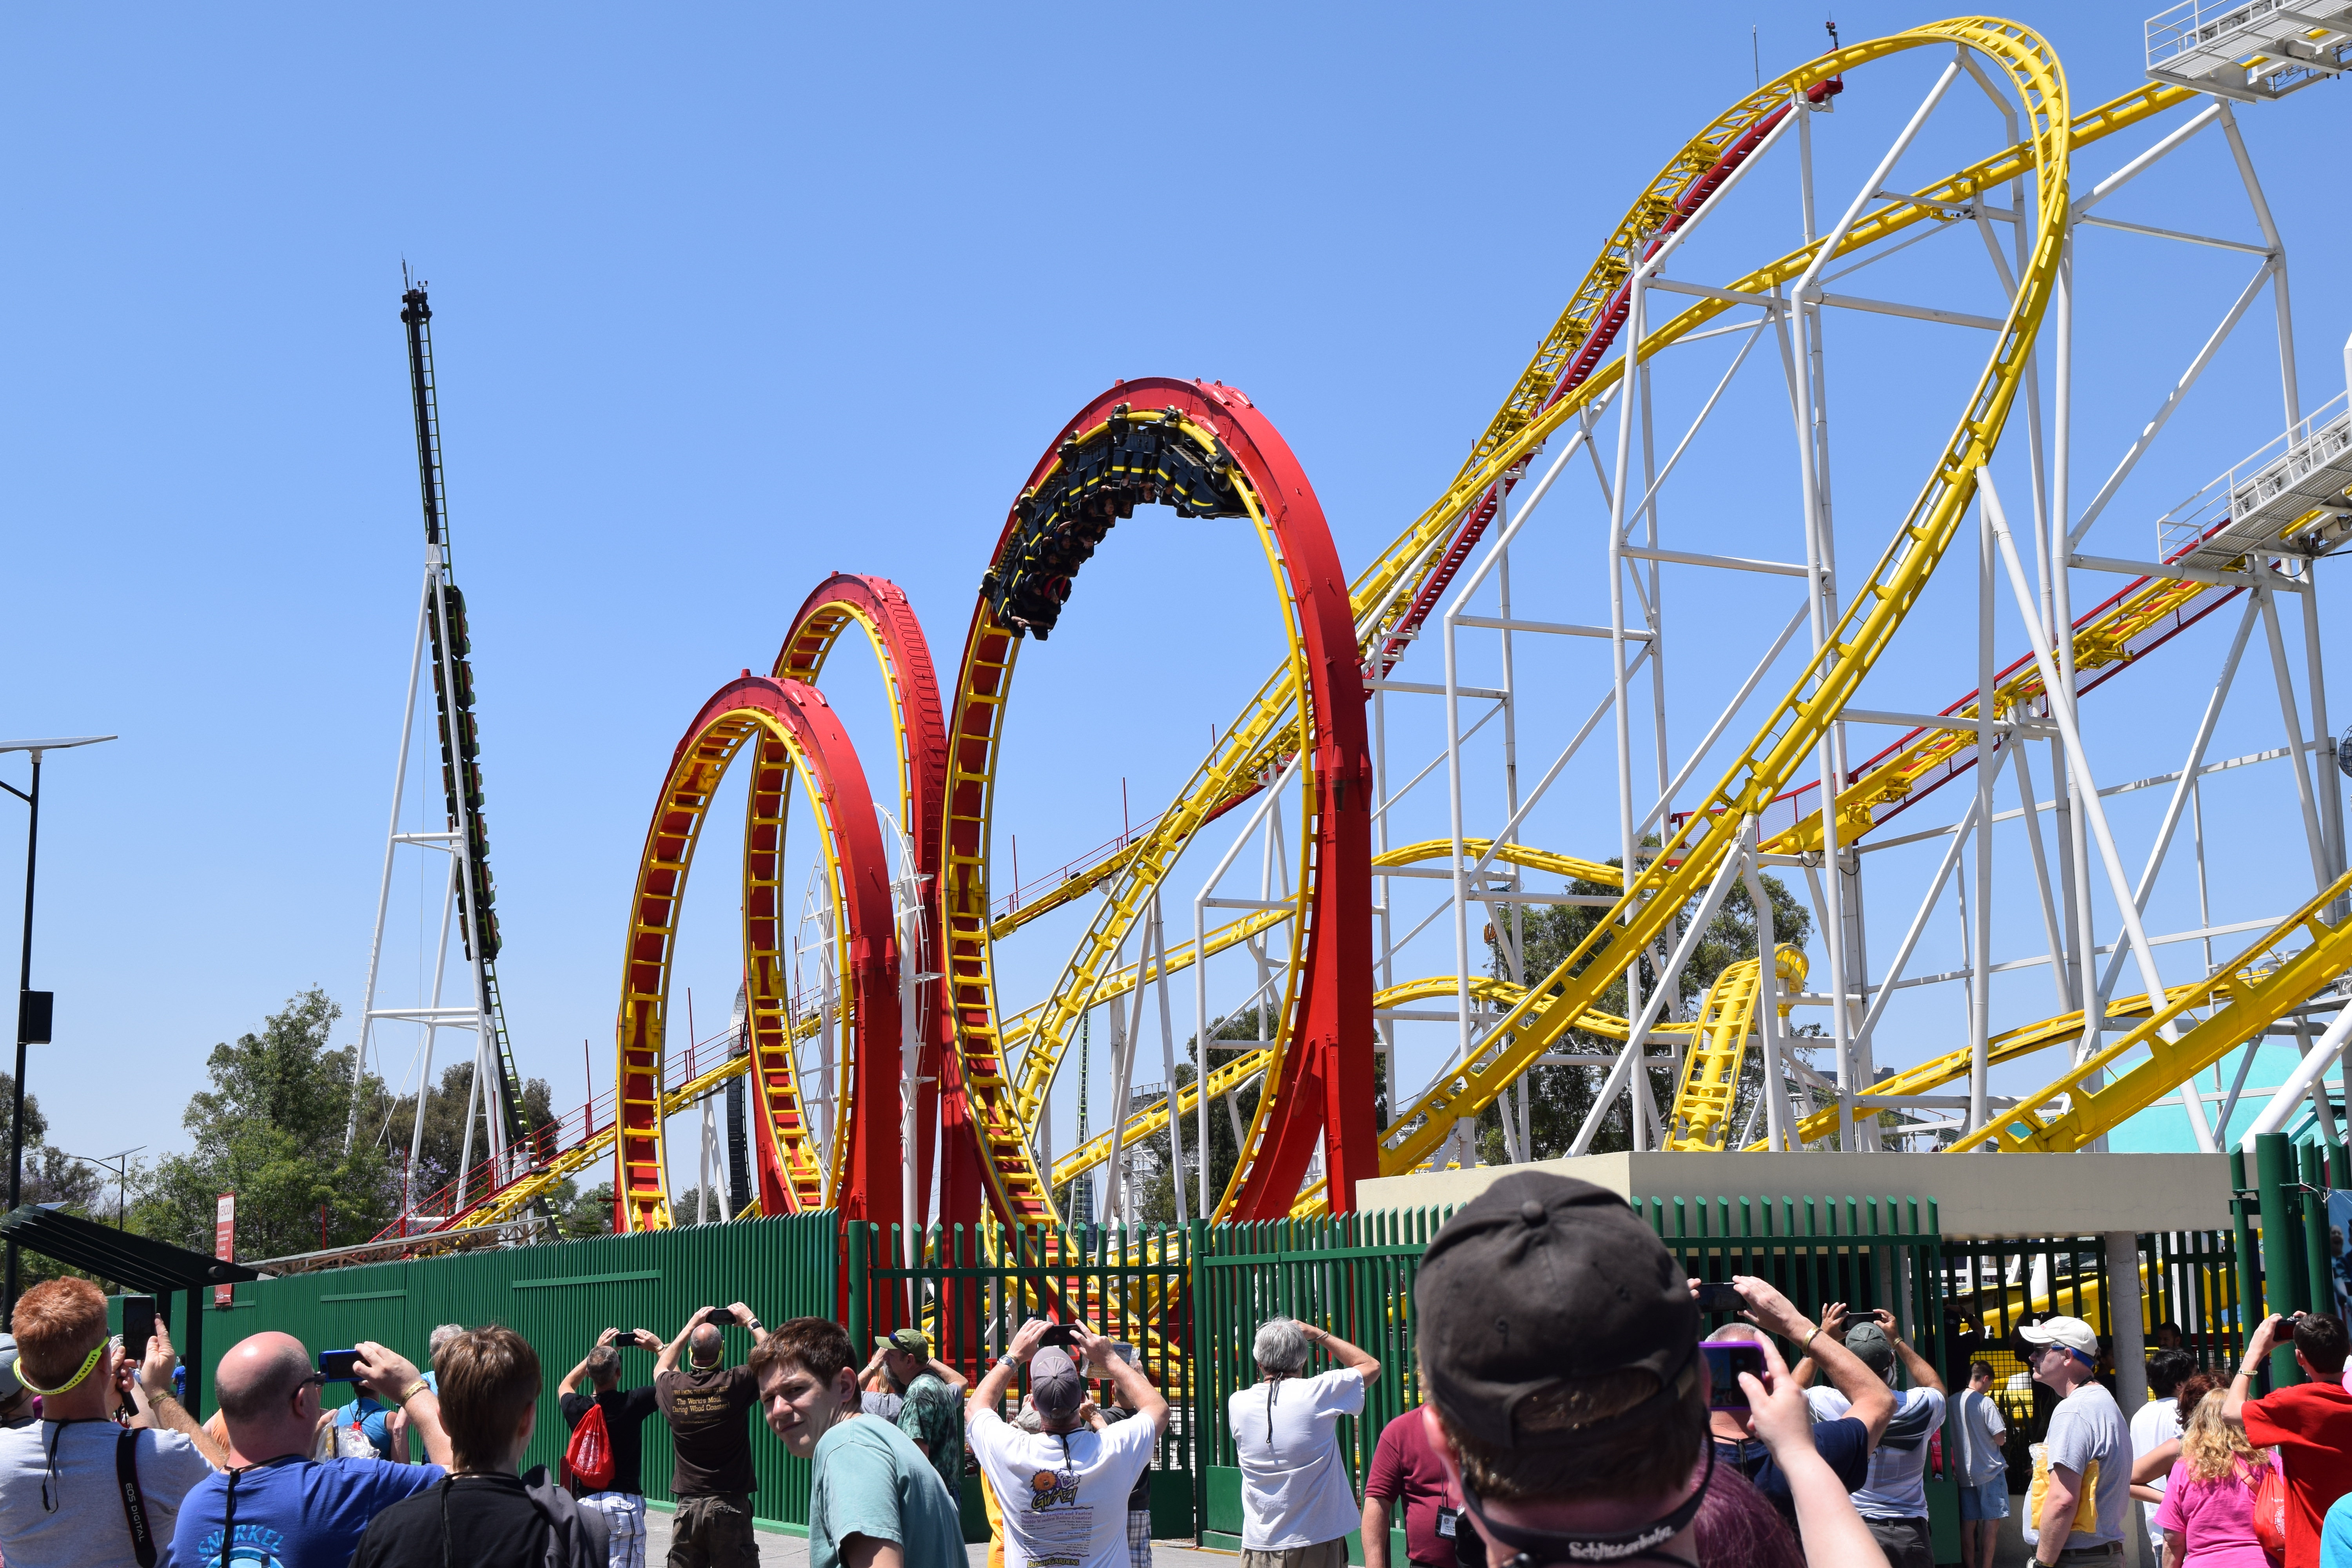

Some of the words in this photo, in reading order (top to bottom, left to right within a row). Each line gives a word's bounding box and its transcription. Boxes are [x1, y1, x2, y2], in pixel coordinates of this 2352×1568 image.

[672, 1406, 688, 1415] Daring
[706, 1402, 730, 1410] Coaster!
[1031, 1486, 1078, 1512] GWAZI
[125, 1483, 136, 1502] EOS
[131, 1505, 145, 1542] DIGITAL
[1048, 1557, 1080, 1566] GARDENS
